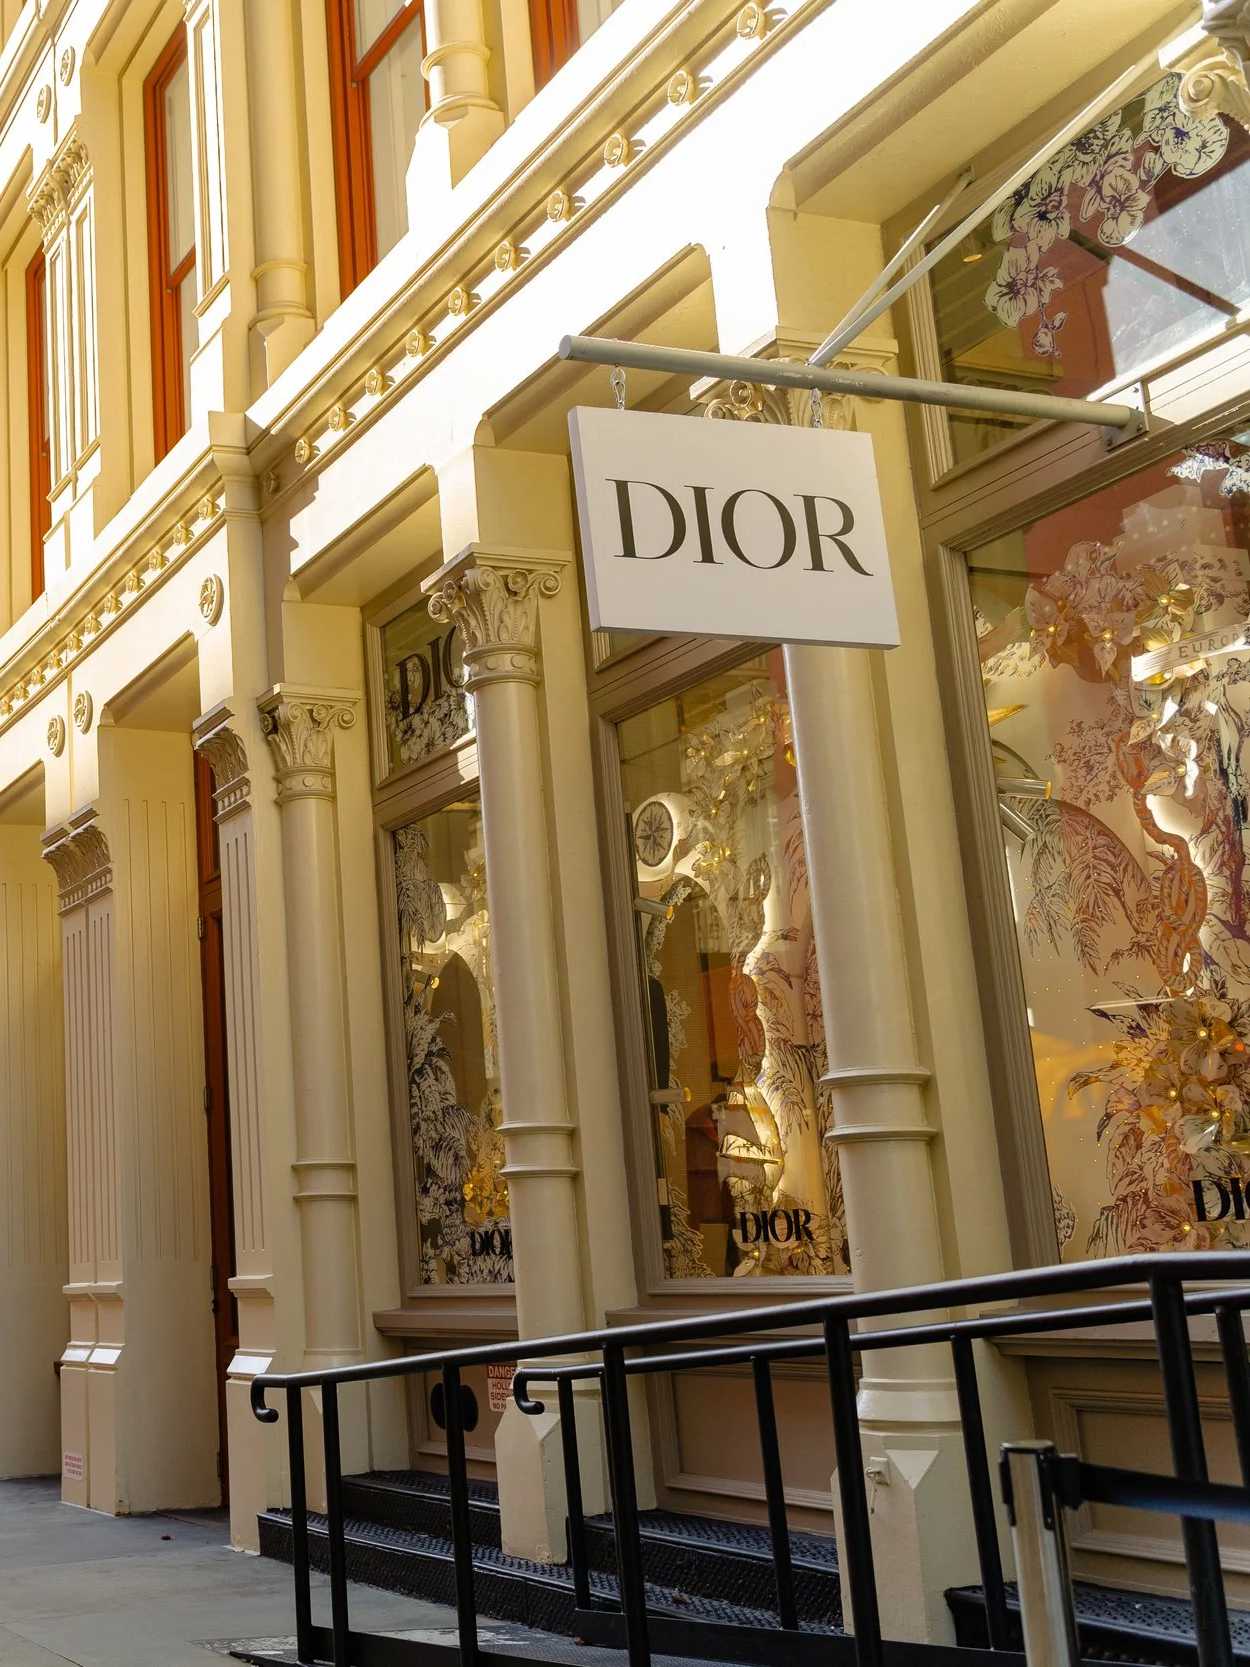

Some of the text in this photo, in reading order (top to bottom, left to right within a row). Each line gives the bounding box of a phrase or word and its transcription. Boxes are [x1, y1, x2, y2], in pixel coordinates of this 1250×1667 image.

[605, 478, 874, 576] DIOR
[1190, 1176, 1250, 1223] DI
[739, 1208, 816, 1243] DIOR
[492, 1381, 511, 1391] HOLL
